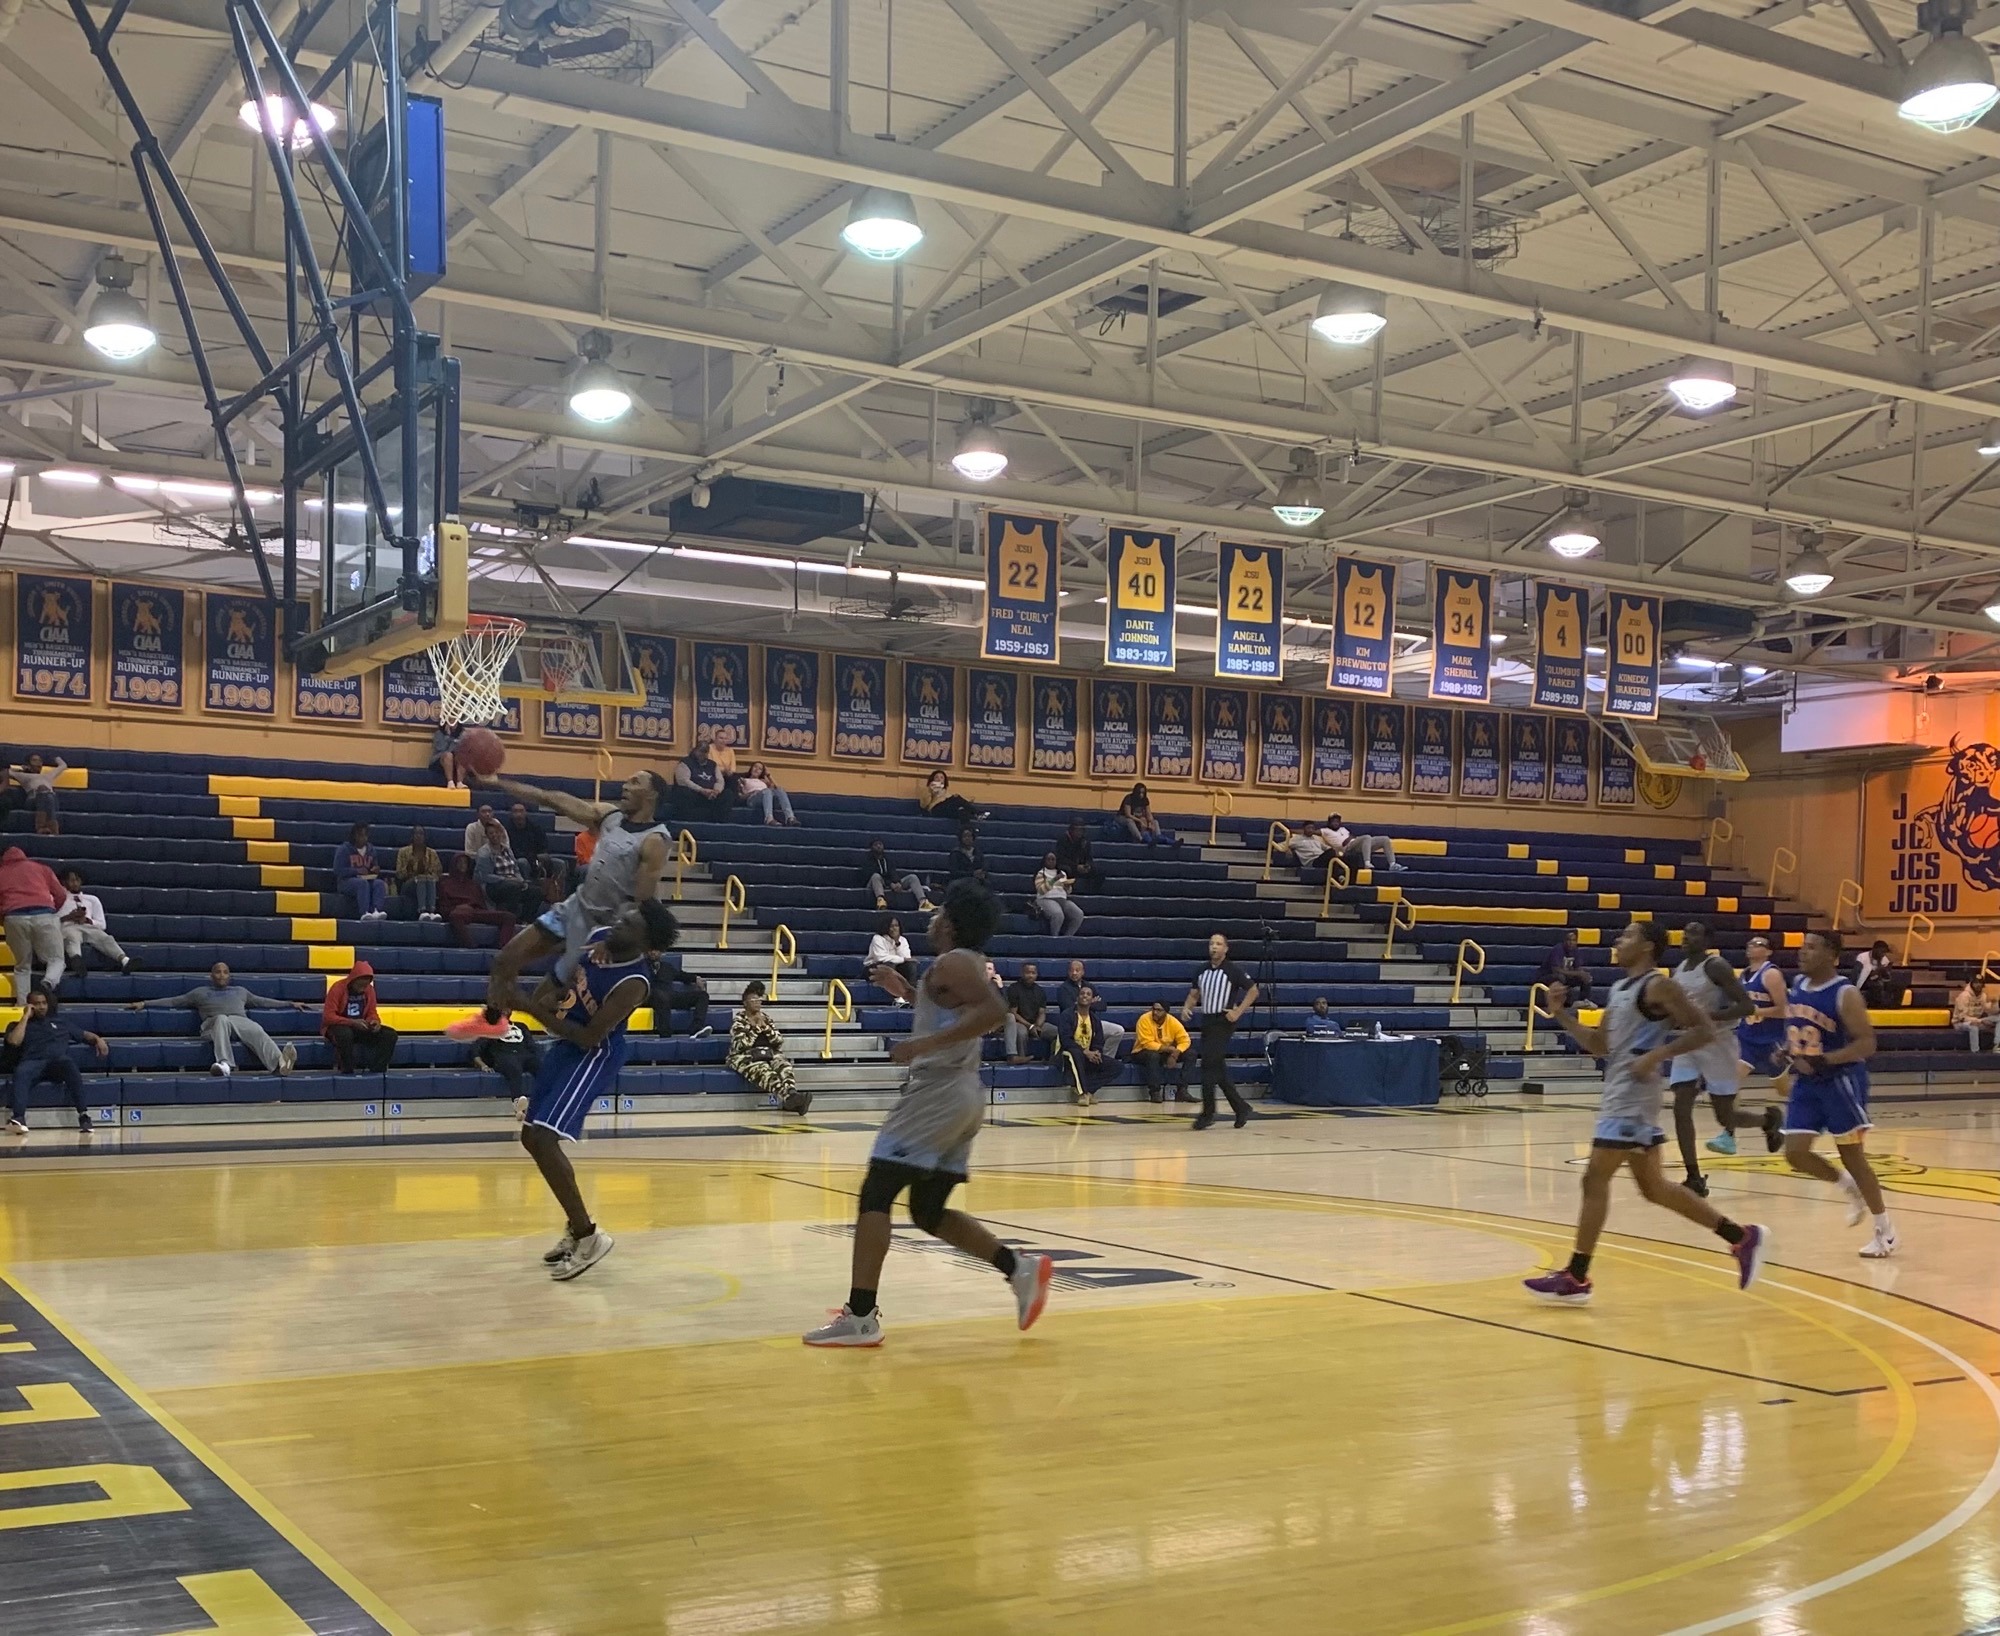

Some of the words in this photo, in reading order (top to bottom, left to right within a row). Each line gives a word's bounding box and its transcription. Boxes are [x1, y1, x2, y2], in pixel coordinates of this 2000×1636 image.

[1014, 544, 1032, 554] JCSU
[1134, 556, 1151, 566] JCSU
[1008, 561, 1039, 589] 22
[1244, 570, 1259, 579] JCSU
[1128, 572, 1156, 597] 40
[1358, 587, 1373, 596] JCSU
[1238, 586, 1263, 612] 22
[991, 607, 1014, 619] FRED
[1353, 602, 1375, 627] 12
[1011, 624, 1033, 636] NEAL
[1126, 619, 1154, 631] DANTE
[1451, 612, 1474, 636] 34
[1119, 632, 1159, 645] JOHNSON
[1233, 631, 1265, 643] ANGELA
[1557, 625, 1566, 647] 4
[994, 639, 1049, 655] 1959-1963
[1228, 643, 1271, 655] HAMILTON
[1624, 633, 1645, 655] 00
[33, 650, 76, 658] TOURNAMENT
[1115, 647, 1167, 663] 1983-1987
[1356, 646, 1371, 658] KIM
[23, 654, 85, 668] RUNNER-UP
[126, 657, 168, 666] TOURNAMENT
[1226, 658, 1275, 672] 1985-1989
[1336, 657, 1388, 672] BREWINGTON
[1452, 655, 1473, 666] MARK
[117, 662, 177, 676] RUNNER-UP
[221, 665, 260, 674] TOURNAMENT
[1545, 665, 1580, 676] COLUMBUS
[20, 668, 86, 696] 1974
[212, 670, 269, 683] RUNNER-UP
[1338, 672, 1383, 689] 1987-1990
[1548, 678, 1576, 689] PARKER
[114, 676, 178, 703] 1992
[301, 678, 357, 691] RUNNER-UP
[209, 683, 271, 710] 1998
[299, 691, 360, 715] 2002
[546, 711, 599, 735] 1982
[621, 713, 671, 739] 1992
[1104, 721, 1129, 732] NCAA
[1159, 725, 1184, 735] NCAA
[767, 726, 814, 749] 2002
[1213, 728, 1239, 740] NCAA
[1268, 733, 1293, 744] NCAA
[905, 738, 951, 760] 2007
[1322, 737, 1345, 748] NCAA
[1373, 741, 1396, 751] NCAA
[1422, 745, 1444, 755] NCAA
[1034, 749, 1074, 769] 2009
[1893, 793, 1907, 820] J
[1892, 823, 1923, 850] JC
[1891, 852, 1940, 880] JCS
[1889, 883, 1958, 912] JCSU
